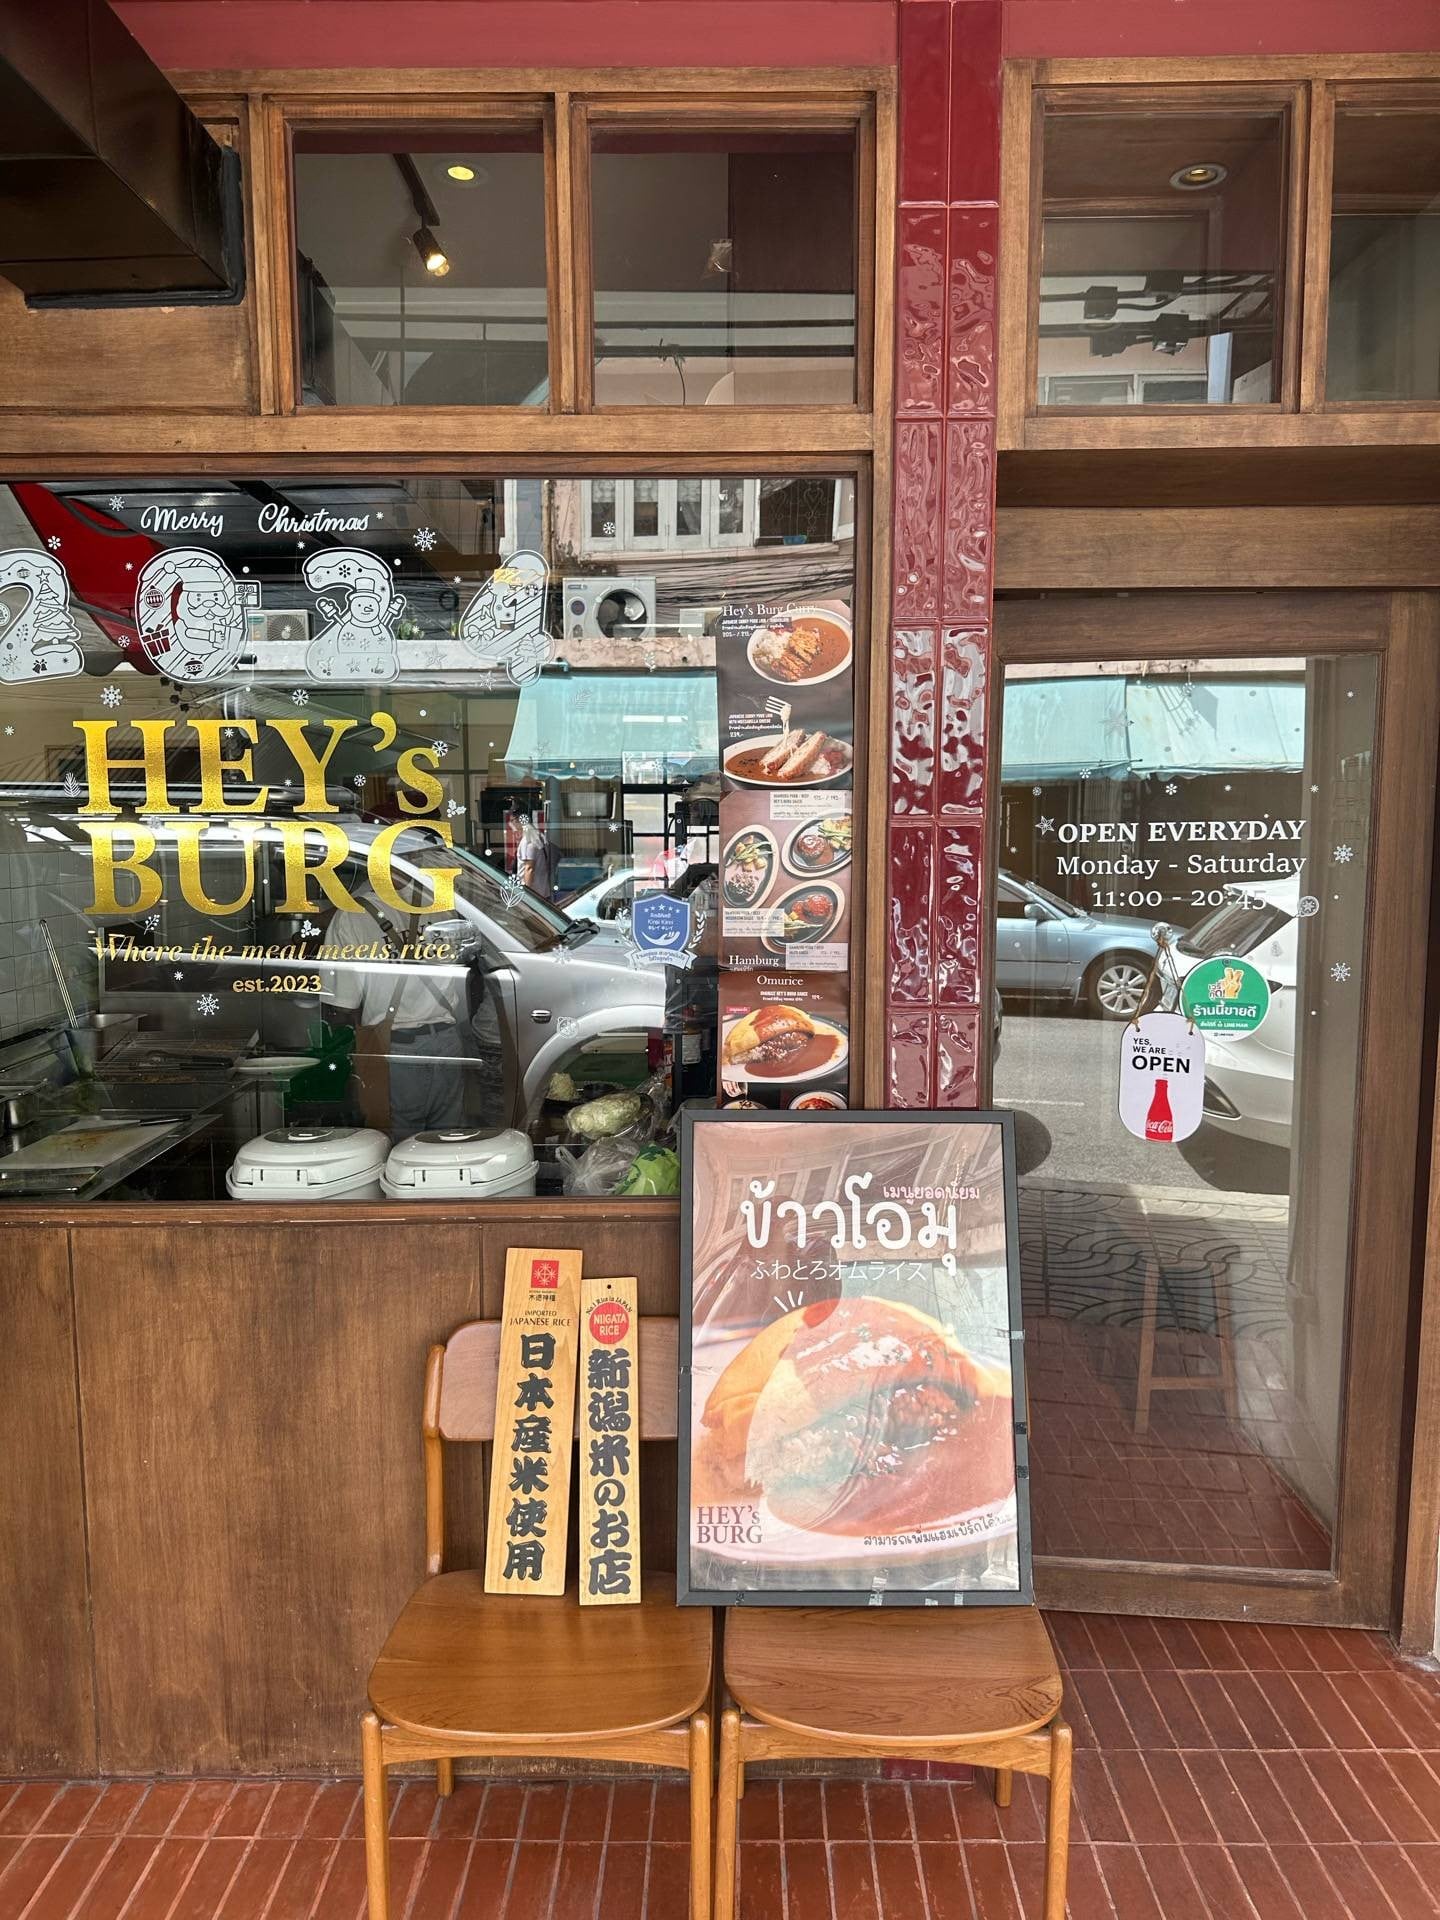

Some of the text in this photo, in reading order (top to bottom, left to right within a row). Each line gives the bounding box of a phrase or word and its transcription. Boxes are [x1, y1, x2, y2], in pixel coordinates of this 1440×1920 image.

[140, 502, 370, 538] Merry Christmas
[723, 604, 753, 618] Hey's
[72, 711, 444, 815] HEY's
[1057, 819, 1307, 844] OPEN EVERYDAY
[77, 818, 463, 917] BURG
[1056, 855, 1160, 881] Monday
[1187, 853, 1307, 881] Saturday
[1092, 889, 1163, 908] 11:00
[1190, 888, 1267, 911] 20:45
[94, 935, 183, 962] Where
[191, 935, 232, 962] the
[240, 938, 306, 961] meal
[316, 940, 391, 960] meets
[399, 935, 456, 961] rice.
[728, 954, 780, 967] Hamburg
[232, 974, 322, 994] est.2023
[756, 974, 804, 986] Omurice
[1193, 1000, 1257, 1018] ร้านนี้ขายดี
[1133, 1038, 1152, 1046] YES,
[1148, 1046, 1166, 1054] ARE
[1132, 1055, 1190, 1074] OPEN
[883, 1180, 980, 1206] เมนูยอดนิยม
[740, 1171, 958, 1277] ข้าวโอมุ
[750, 1259, 927, 1281] ふわとろオムライス
[510, 1317, 571, 1327] JAPANESE RICE
[593, 1313, 627, 1325] NIIGATA
[599, 1325, 620, 1336] RICE
[503, 1332, 557, 1581] 日本産米使用
[587, 1348, 632, 1595] 新潟米のお店
[696, 1505, 760, 1526] HEY's
[696, 1526, 764, 1545] BURG
